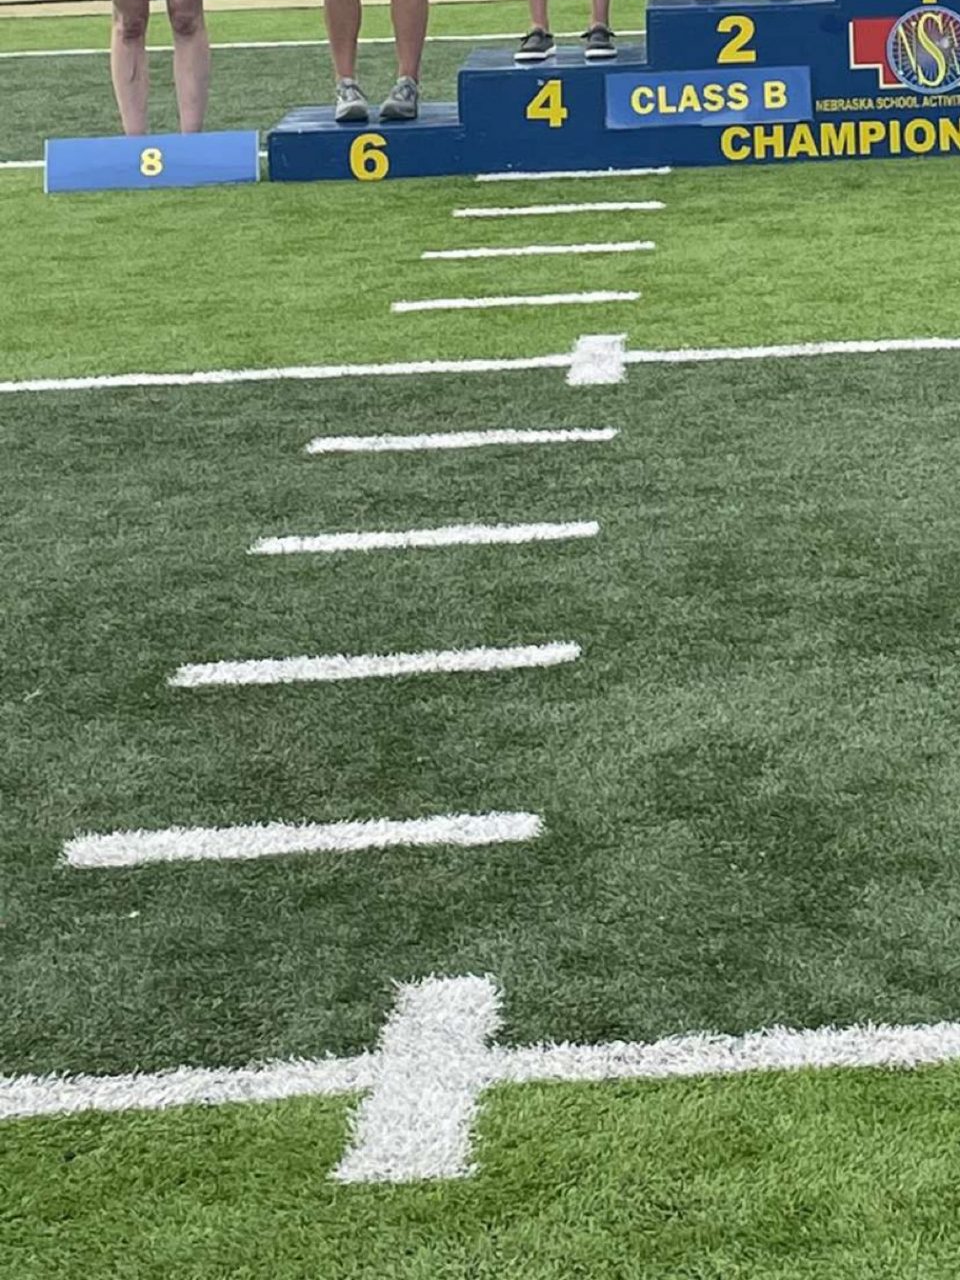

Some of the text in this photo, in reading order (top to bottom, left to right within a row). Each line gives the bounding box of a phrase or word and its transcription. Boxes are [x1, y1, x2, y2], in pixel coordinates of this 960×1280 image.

[716, 14, 757, 64] 2
[526, 79, 568, 128] 4
[630, 80, 788, 115] CLASS B
[816, 97, 875, 111] NEBRASKA
[875, 95, 920, 109] SCHOOL
[139, 147, 163, 177] 8
[349, 132, 390, 182] 6
